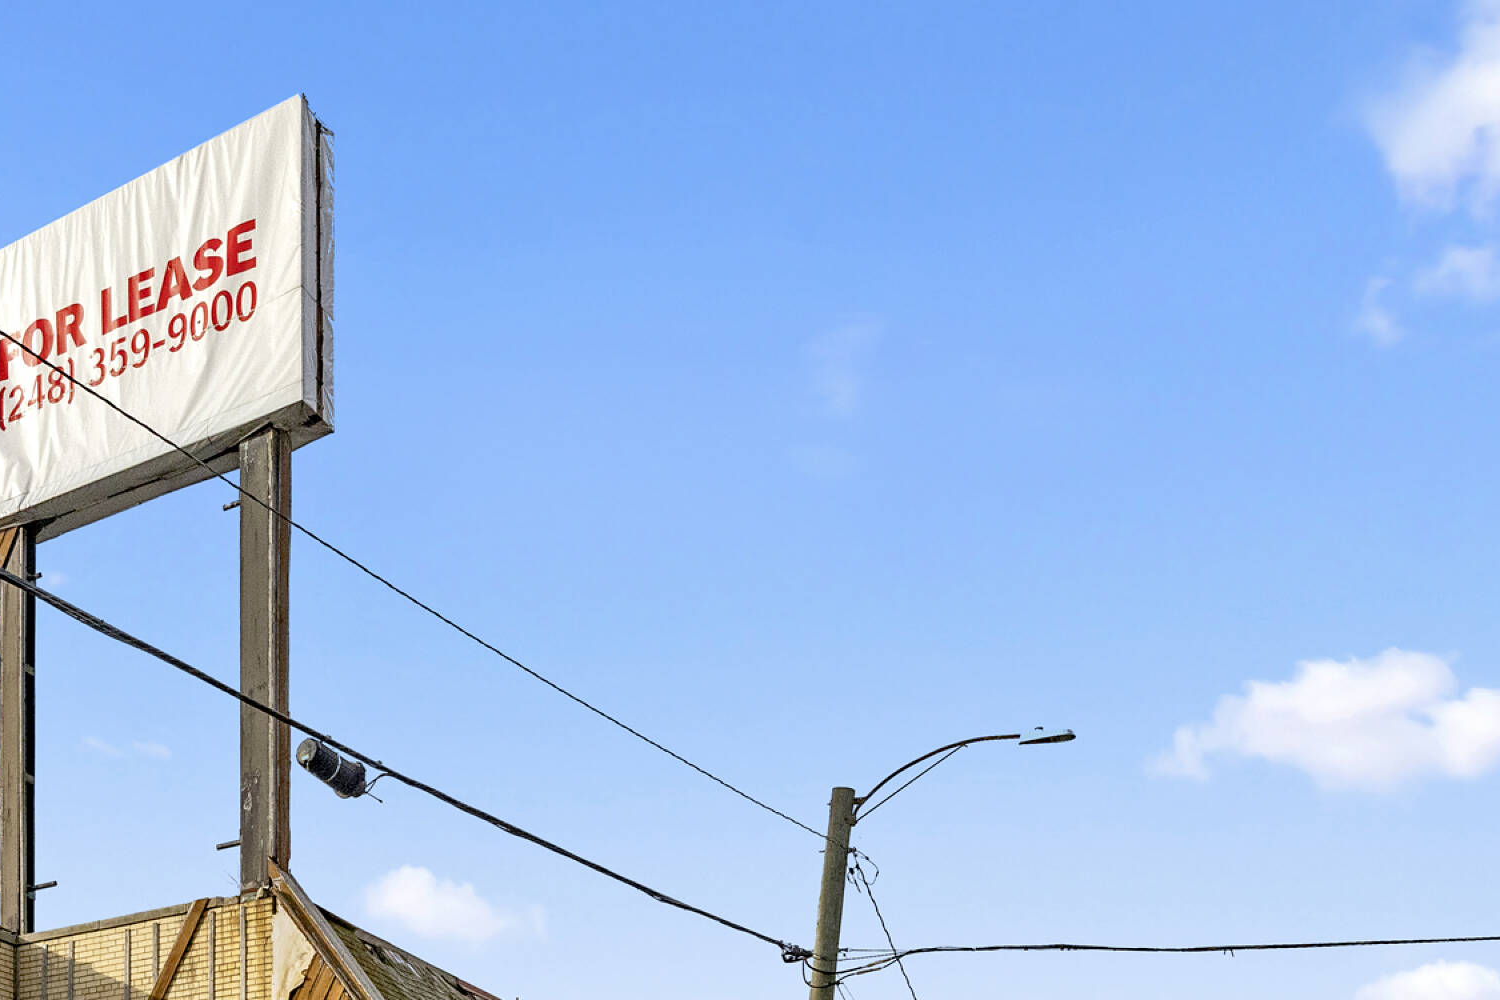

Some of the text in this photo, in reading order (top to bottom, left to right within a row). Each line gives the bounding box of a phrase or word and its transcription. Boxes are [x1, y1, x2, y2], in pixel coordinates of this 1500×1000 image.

[100, 218, 257, 336] LEASE
[0, 280, 258, 432] (248) 359-9000
